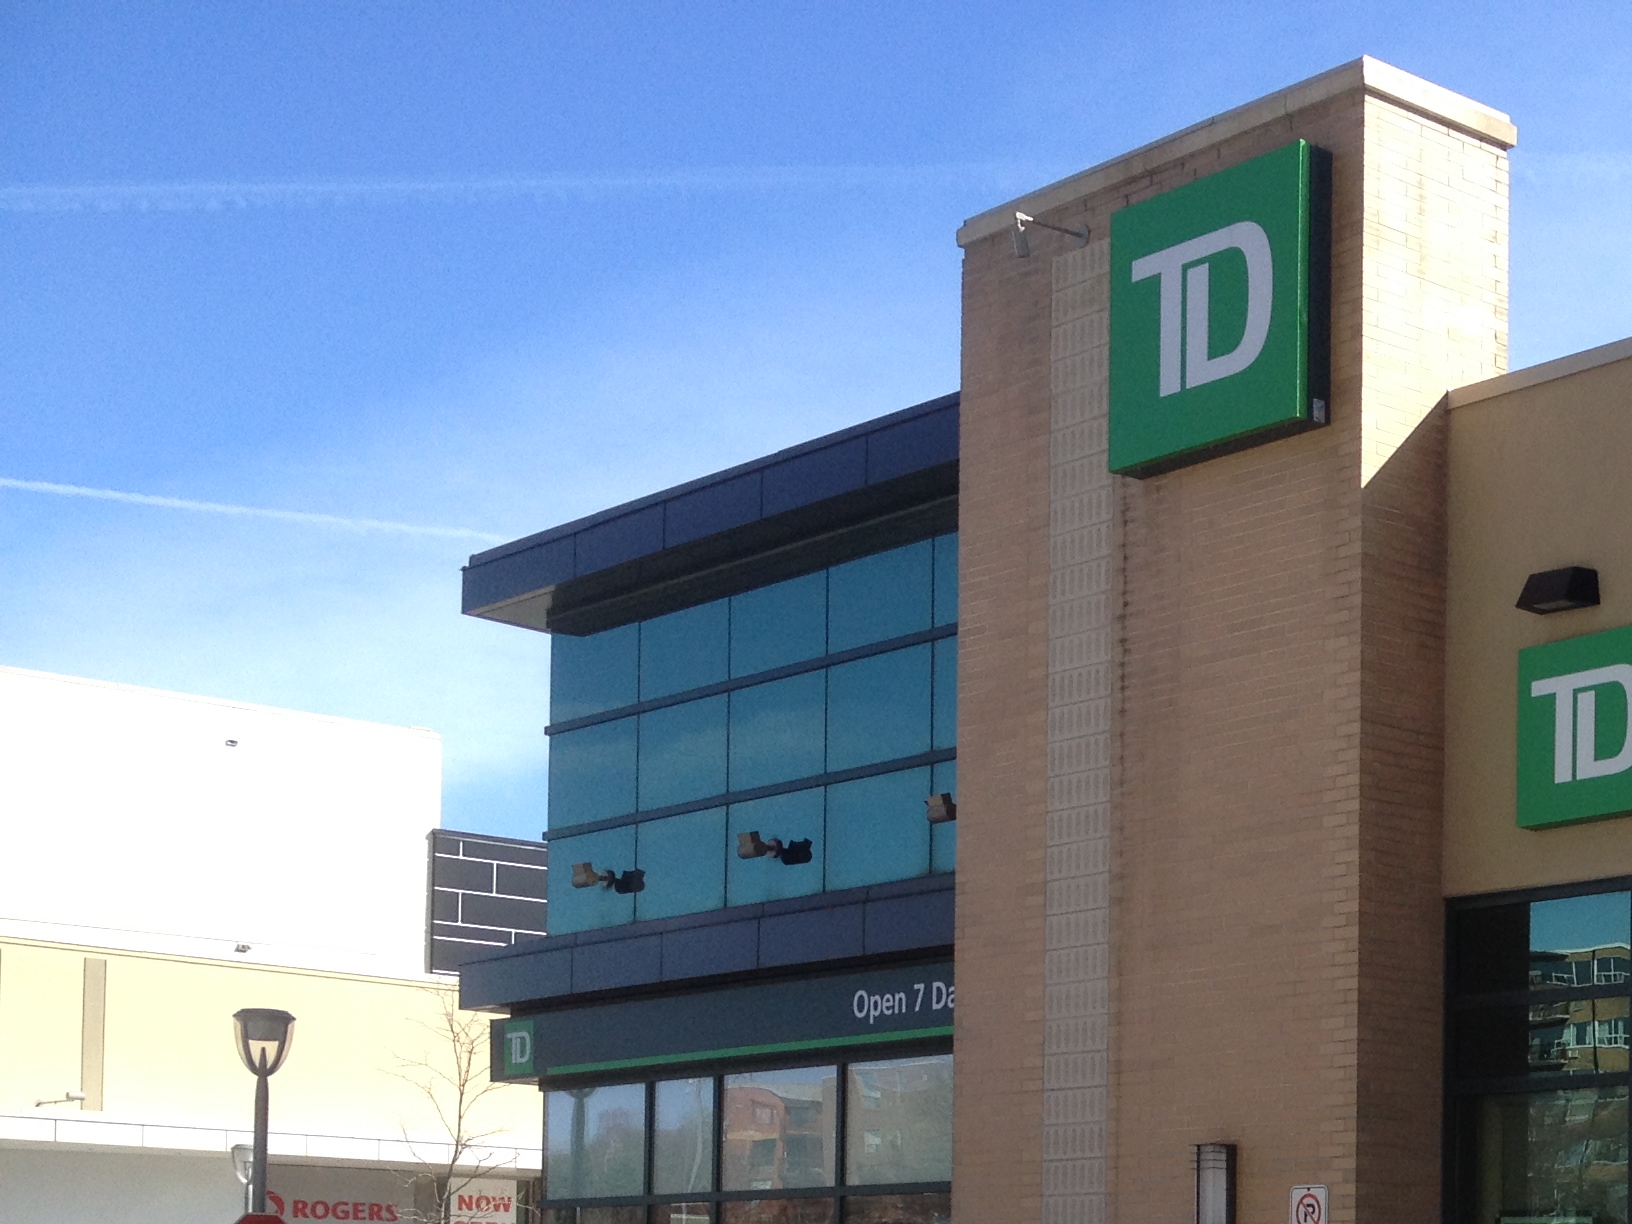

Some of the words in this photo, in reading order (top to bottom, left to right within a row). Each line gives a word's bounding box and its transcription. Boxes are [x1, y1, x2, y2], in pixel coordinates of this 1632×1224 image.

[1131, 220, 1274, 398] TD
[853, 987, 906, 1024] Open
[913, 983, 925, 1012] 7
[506, 1029, 531, 1064] TD
[292, 1199, 399, 1223] ROGERS
[457, 1194, 514, 1213] NOW
